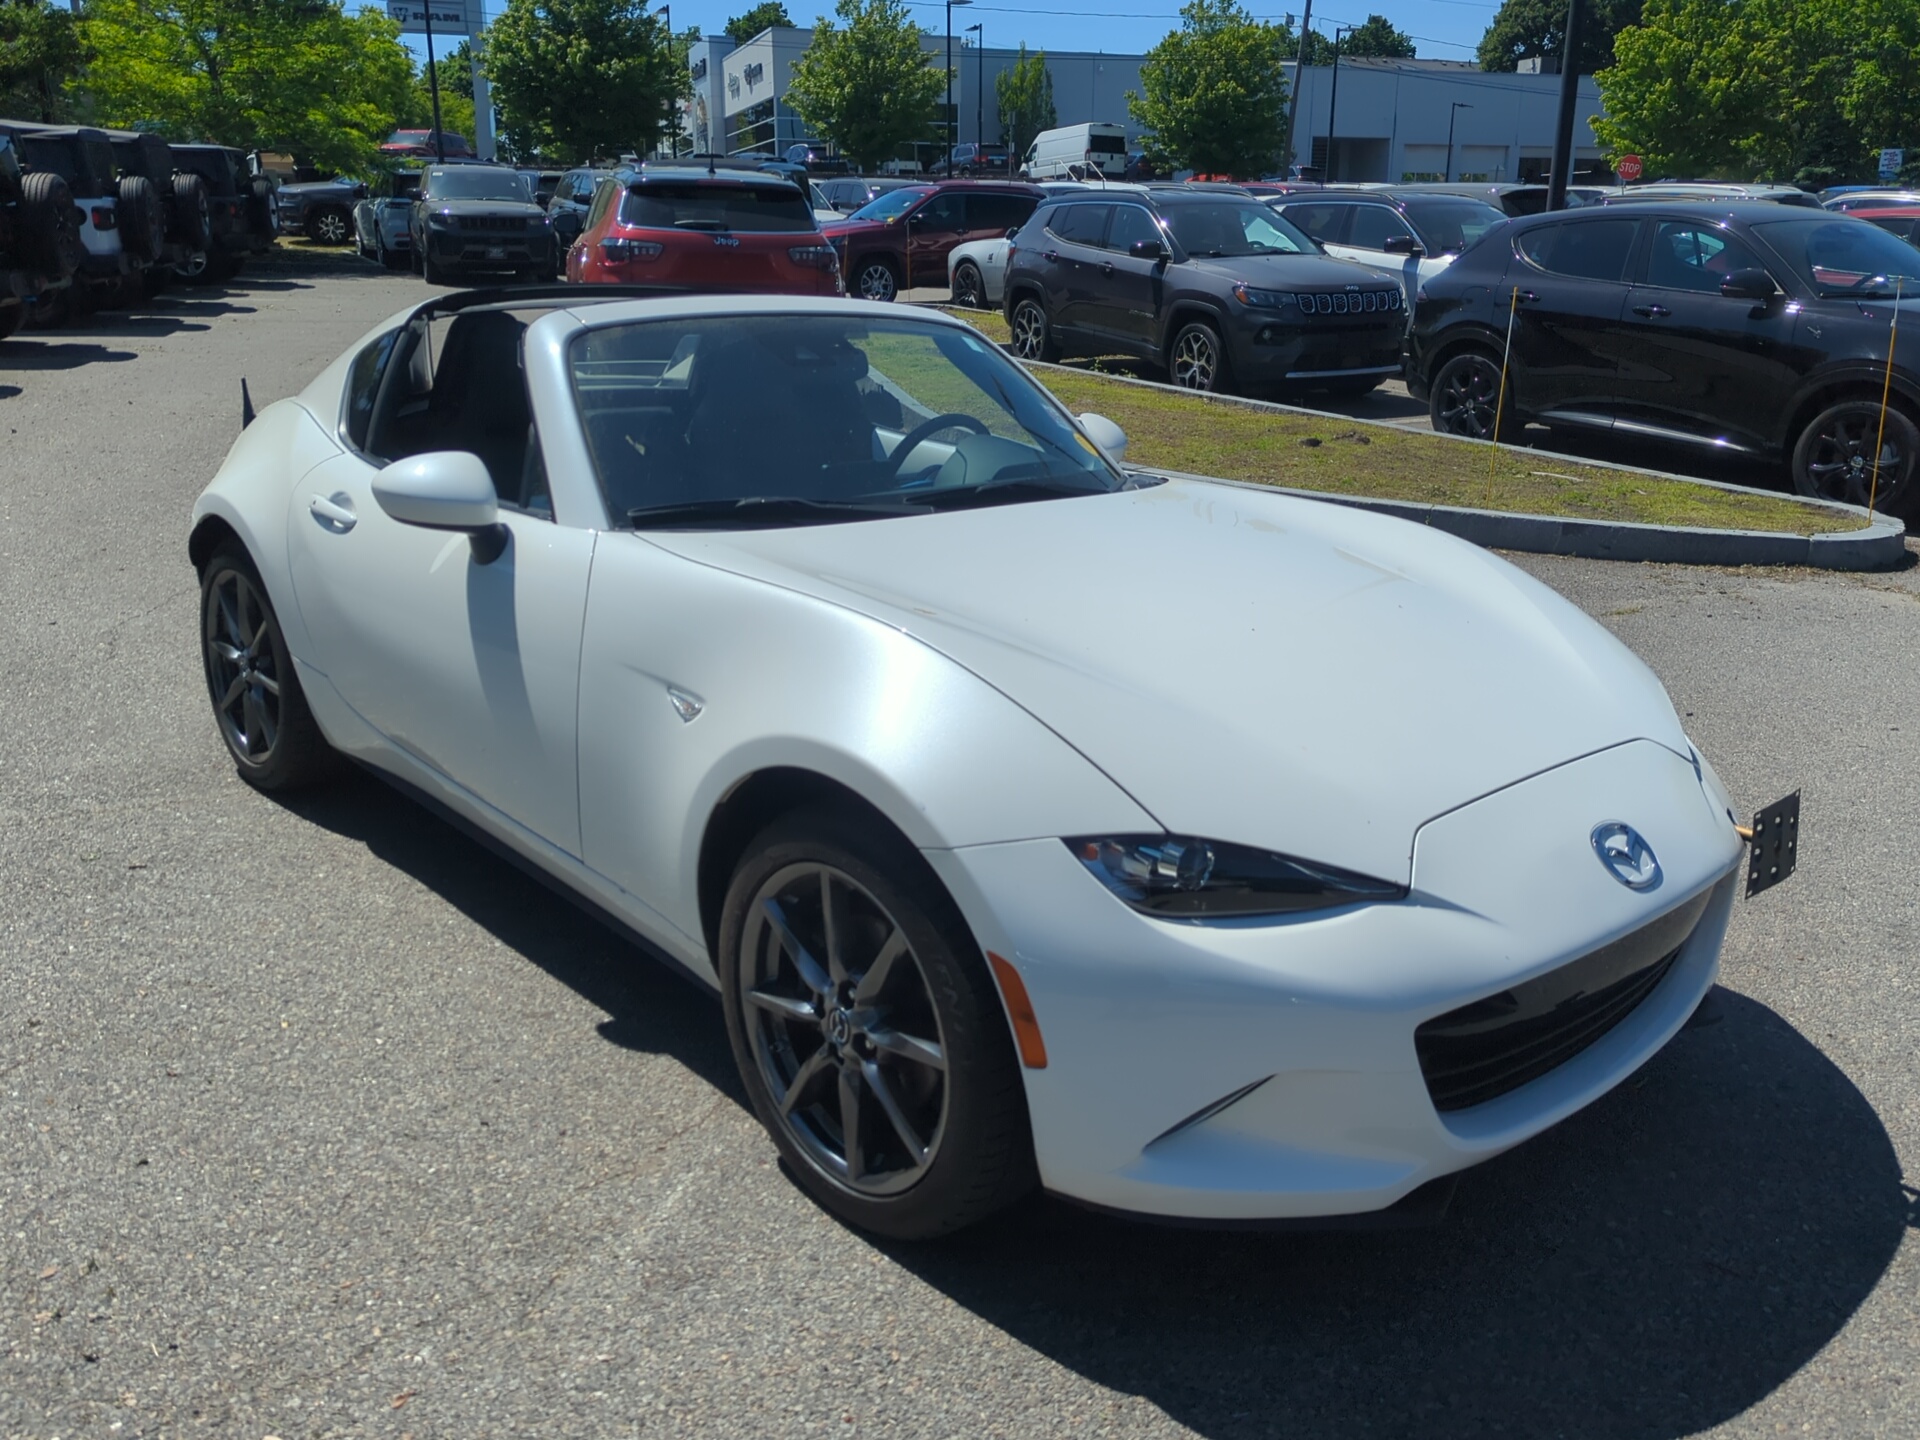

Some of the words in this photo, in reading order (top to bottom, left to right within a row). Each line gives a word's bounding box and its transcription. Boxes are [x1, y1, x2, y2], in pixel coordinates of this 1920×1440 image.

[413, 12, 460, 22] RAM
[1619, 162, 1641, 173] STOP
[713, 236, 740, 247] Jeep
